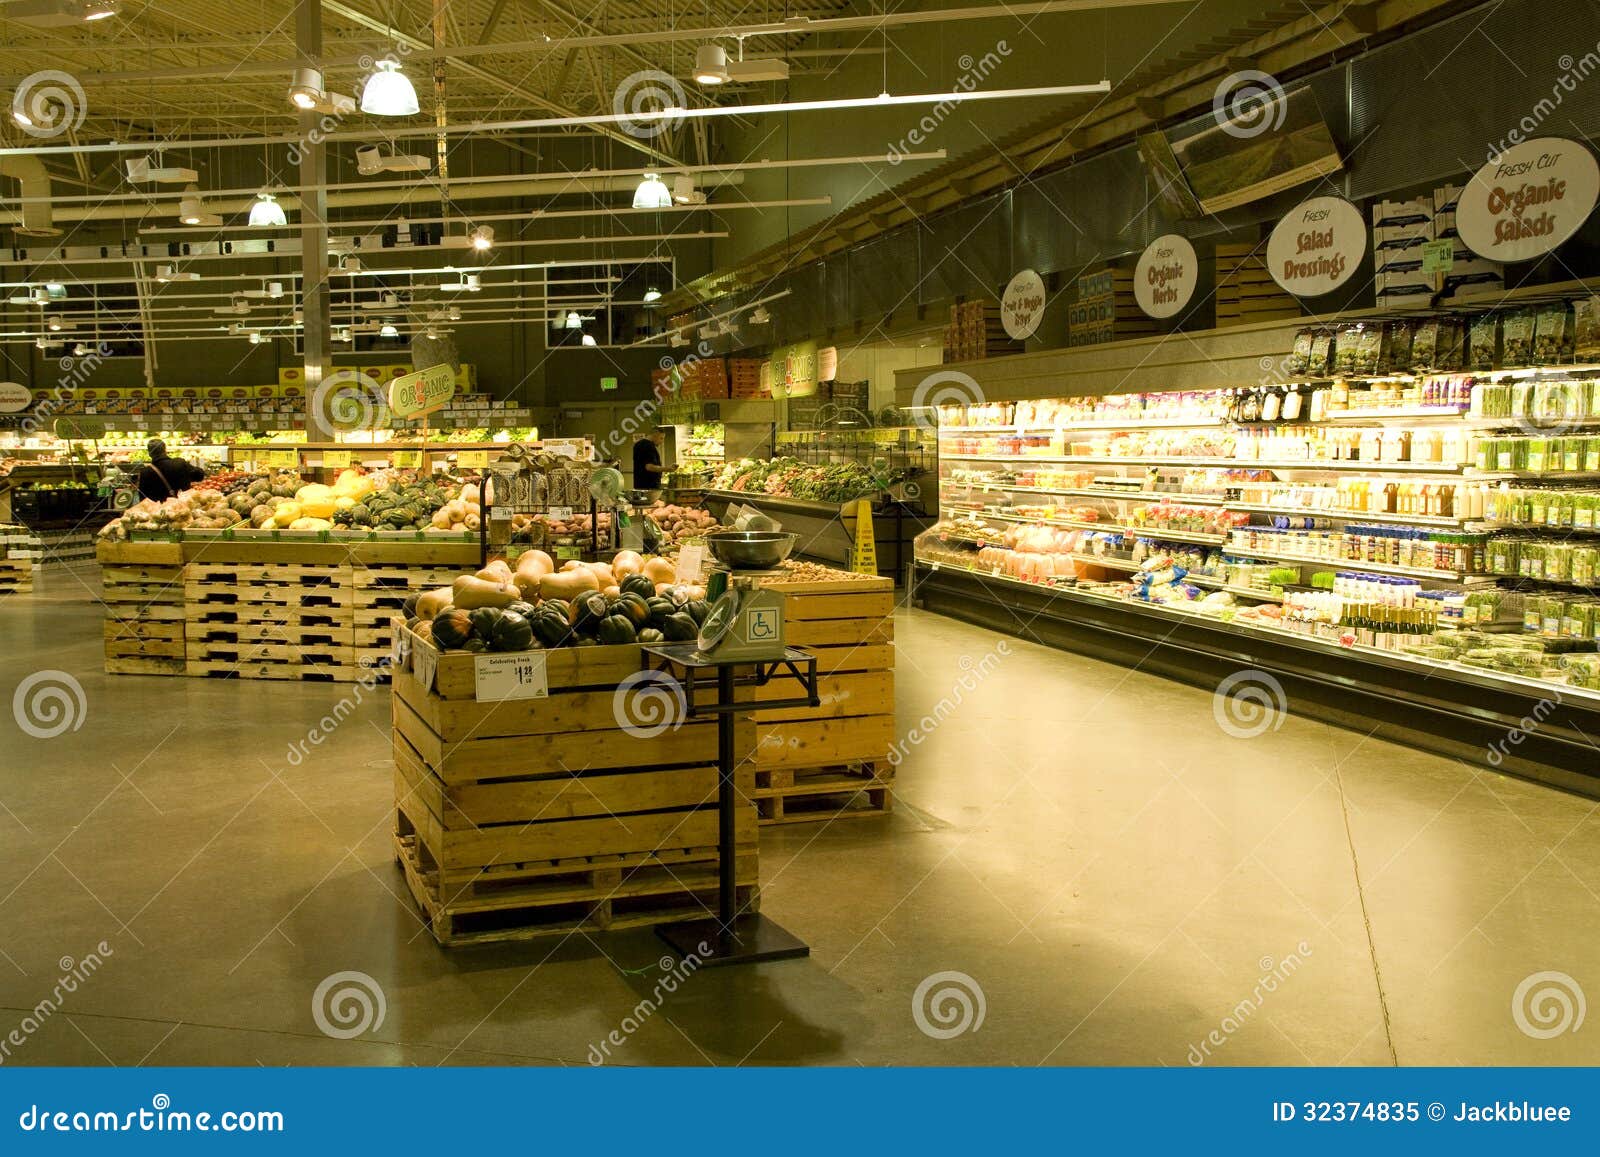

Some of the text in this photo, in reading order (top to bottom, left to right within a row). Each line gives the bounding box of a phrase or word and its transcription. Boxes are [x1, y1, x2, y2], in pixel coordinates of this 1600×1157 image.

[1494, 153, 1563, 180] FRESH CUT
[1487, 177, 1566, 218] Organic
[1302, 209, 1331, 224] FRESH
[1492, 211, 1556, 247] Salads
[1296, 226, 1334, 255] Salad
[1148, 262, 1183, 288] Organic
[1284, 251, 1346, 280] Dressings
[1153, 285, 1178, 305] Herbs
